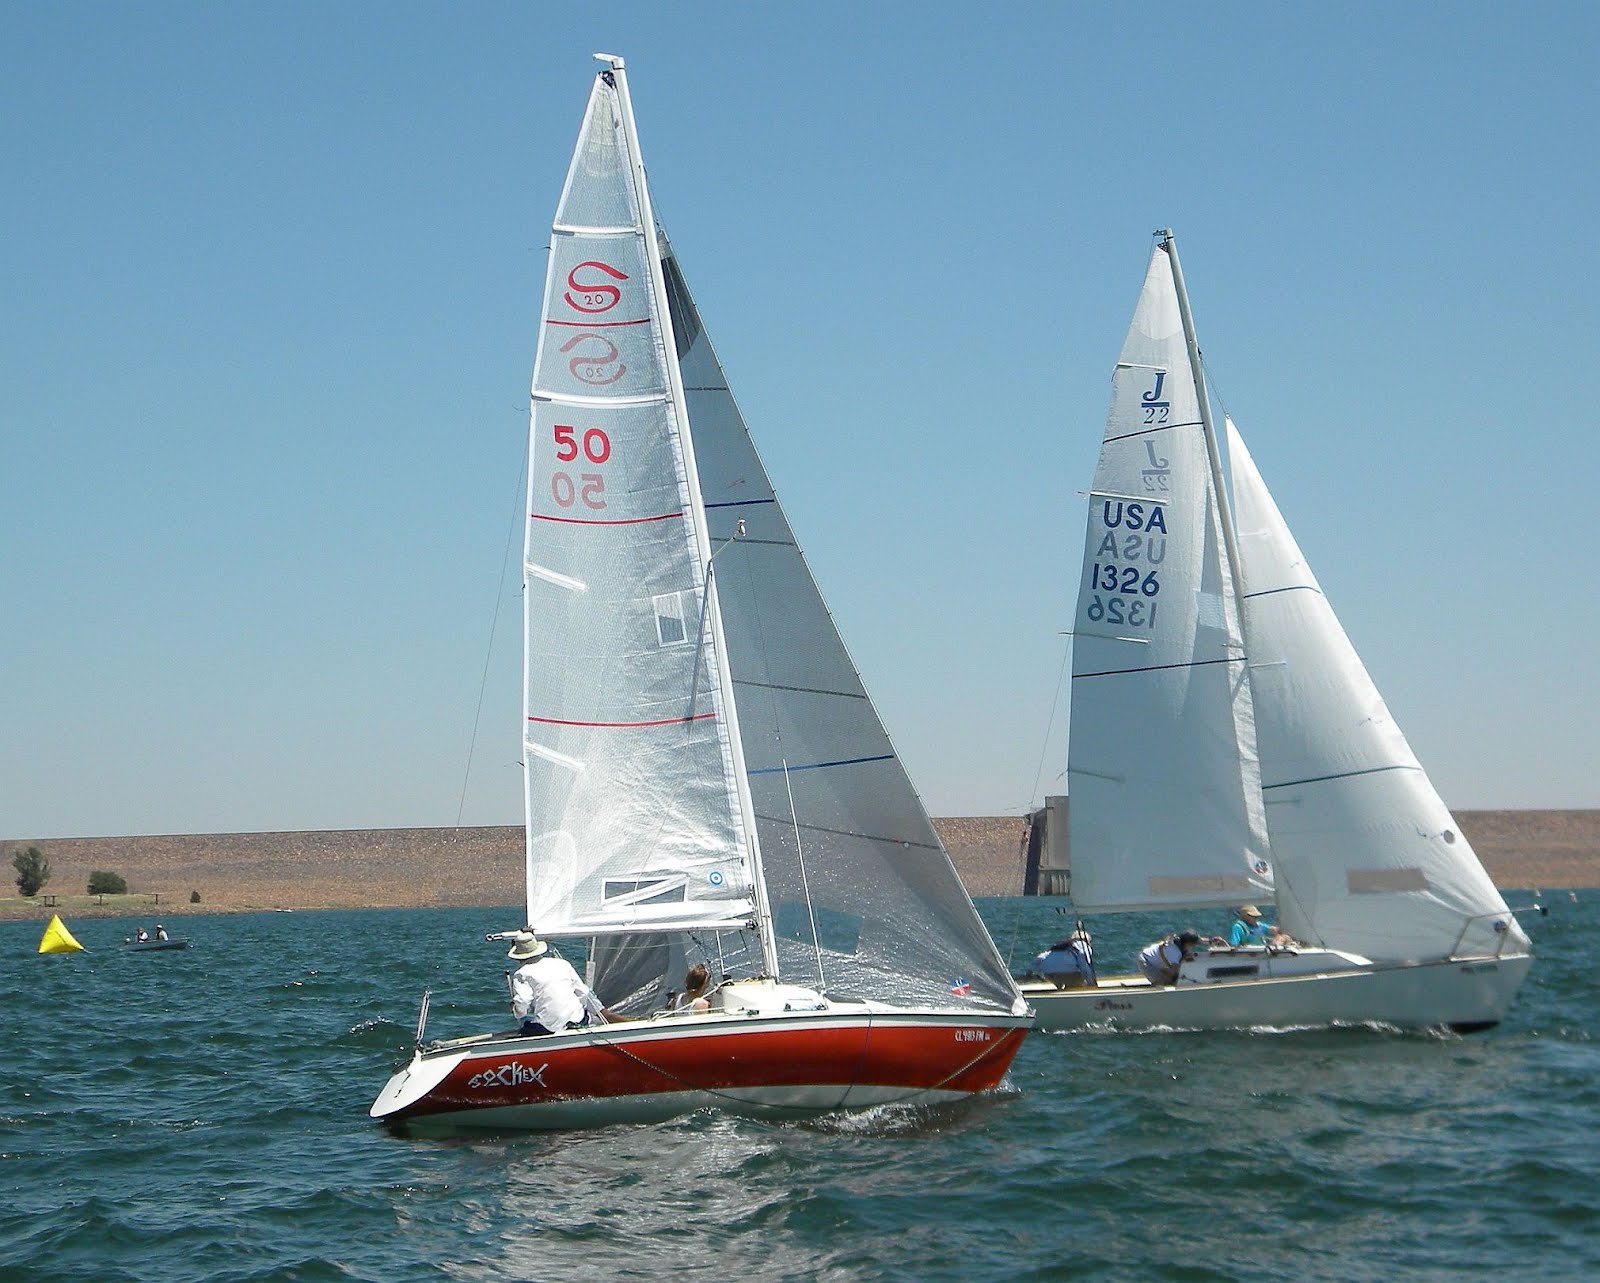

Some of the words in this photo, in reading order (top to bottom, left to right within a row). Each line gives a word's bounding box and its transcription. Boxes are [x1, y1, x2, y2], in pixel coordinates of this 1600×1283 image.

[584, 294, 604, 305] 20
[1142, 372, 1167, 402] J
[1143, 407, 1170, 424] 22
[553, 424, 611, 464] 50
[1103, 500, 1168, 535] USA
[1091, 563, 1160, 597] 1326
